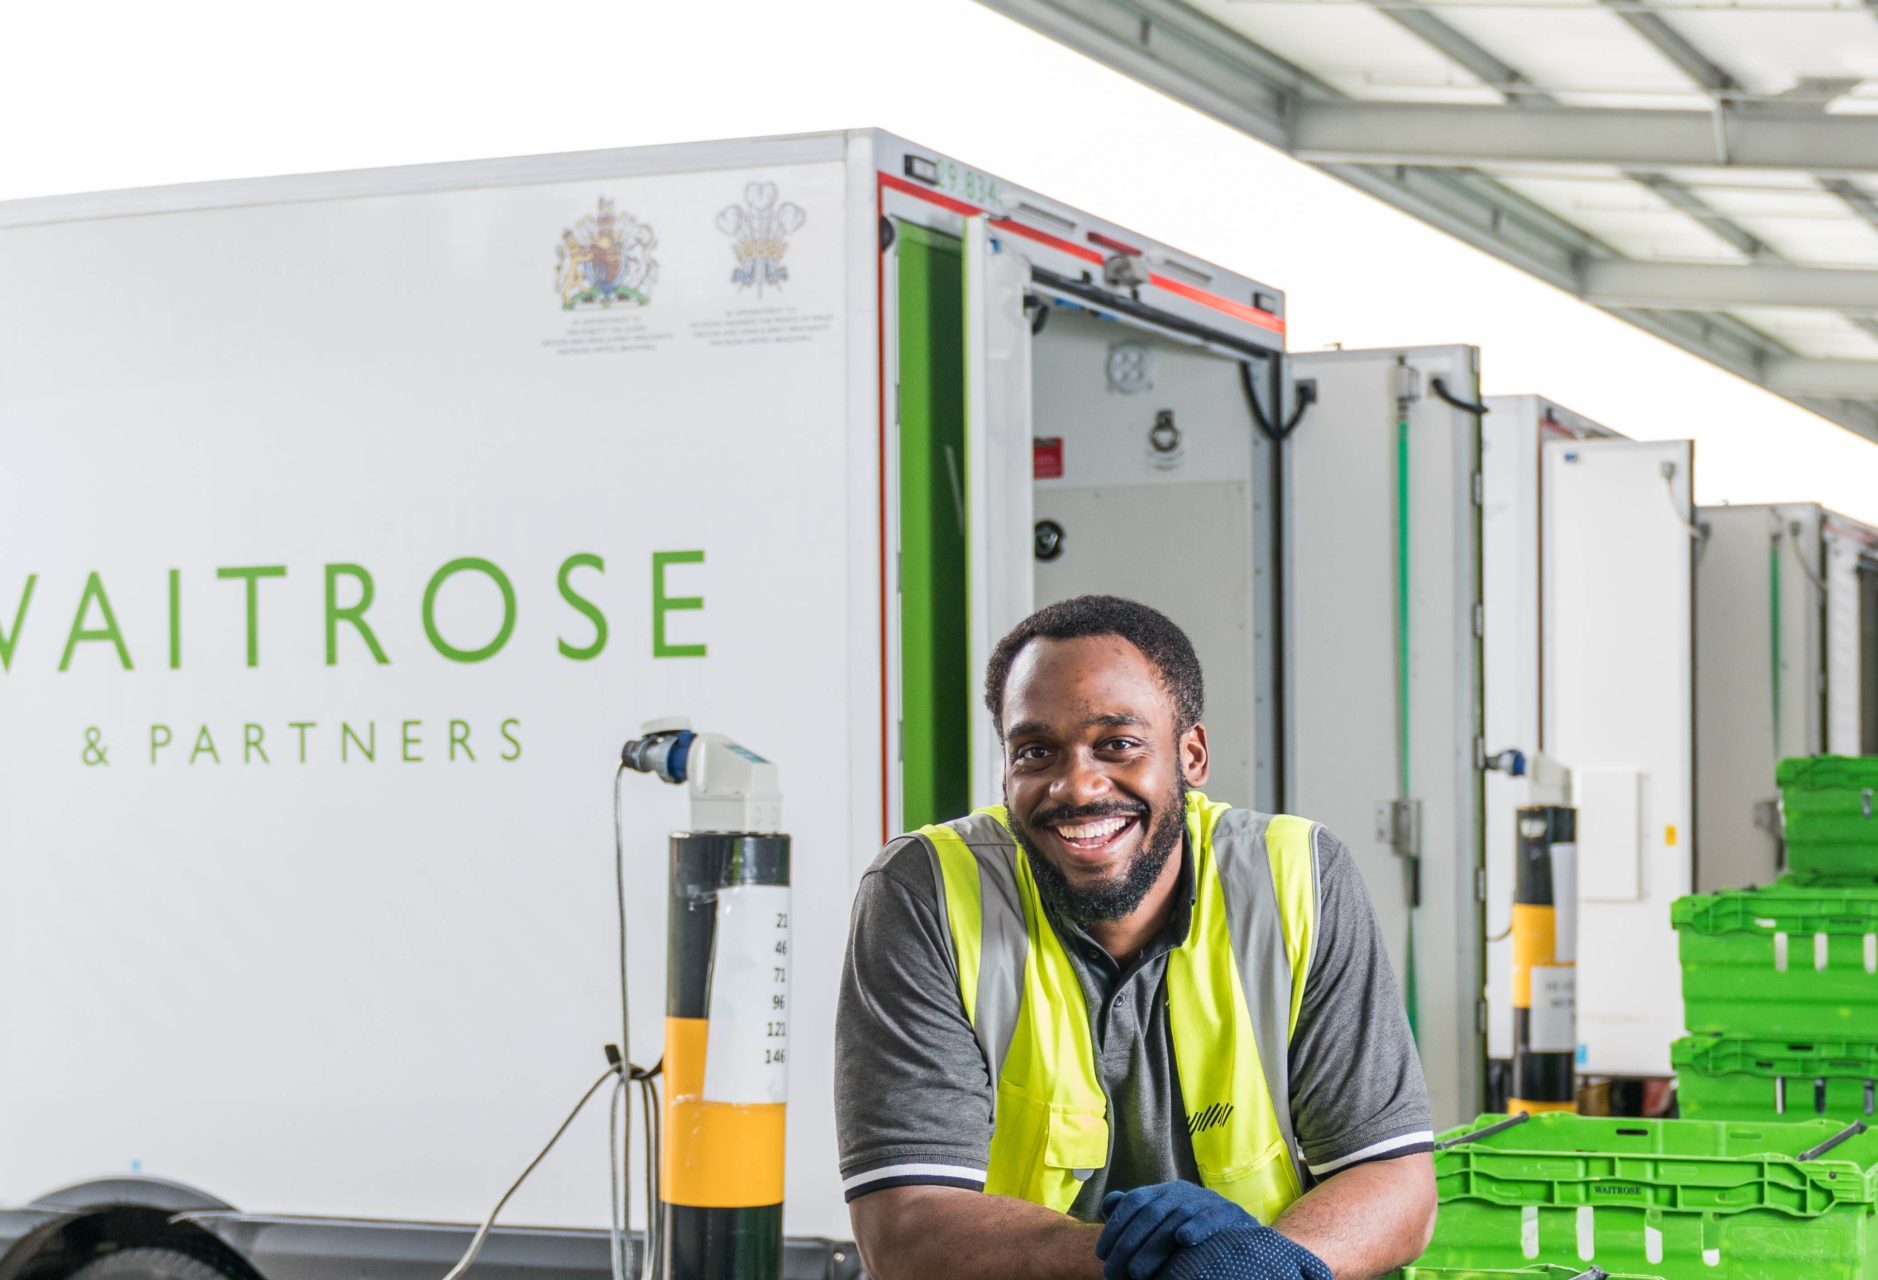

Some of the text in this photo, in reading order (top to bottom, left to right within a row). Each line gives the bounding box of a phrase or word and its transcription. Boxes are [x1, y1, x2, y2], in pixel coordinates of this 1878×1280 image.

[81, 717, 523, 767] & PARTNERS
[776, 913, 788, 929] 21
[774, 967, 786, 983] 71
[772, 994, 785, 1010] 96
[767, 1021, 786, 1037] 121
[1594, 1185, 1642, 1195] WAITROSE
